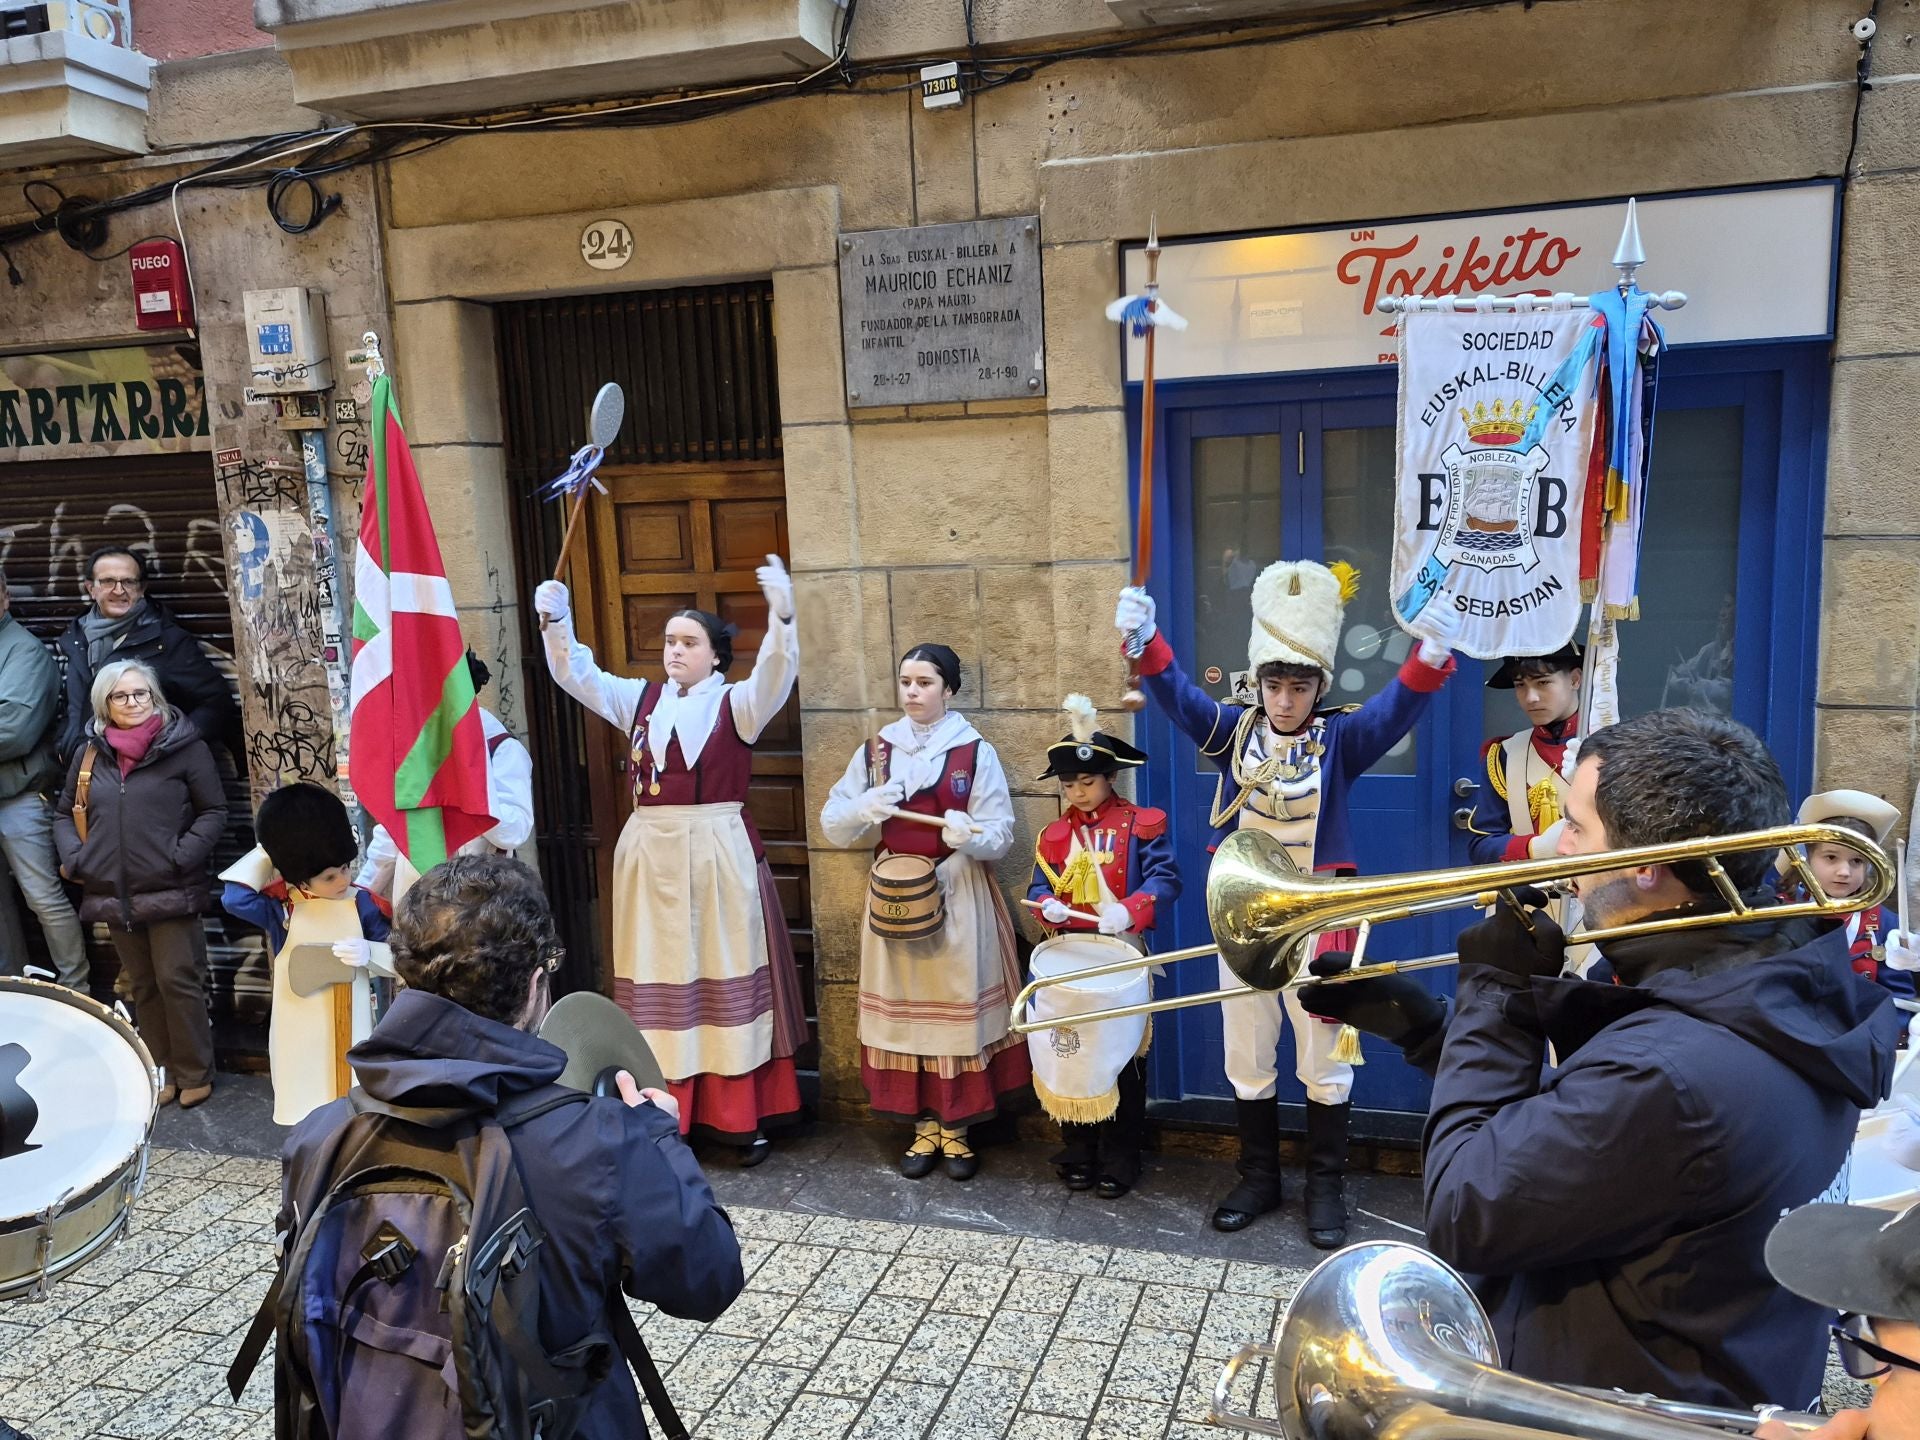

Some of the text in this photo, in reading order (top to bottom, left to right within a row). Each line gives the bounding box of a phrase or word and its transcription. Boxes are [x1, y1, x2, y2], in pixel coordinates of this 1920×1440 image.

[924, 77, 957, 95] 173018
[587, 229, 628, 260] 24
[1351, 230, 1375, 242] UN
[132, 255, 170, 270] FUEGO
[862, 254, 875, 267] LA
[1009, 241, 1017, 255] A
[865, 264, 1013, 294] MAURICIO ECHANIZ
[1337, 227, 1582, 315] Txikito
[861, 309, 1021, 332] FUNDADOR DE LA TAMBORRADA
[862, 336, 905, 350] INFANTIL
[1462, 330, 1554, 352] SOCIEDAD
[918, 348, 981, 367] DONOSTIA
[335, 402, 355, 412] FCK
[1421, 361, 1578, 434] EUSKAL-BILLERA
[336, 411, 356, 420] NZS
[1470, 453, 1518, 464] NOBLEZA
[1416, 473, 1567, 539] E B
[1441, 462, 1459, 546] POR FIDELIDAD
[1461, 550, 1516, 566] GANADAS
[1454, 574, 1563, 619] SEBASTIAN
[1236, 692, 1254, 700] TOKO
